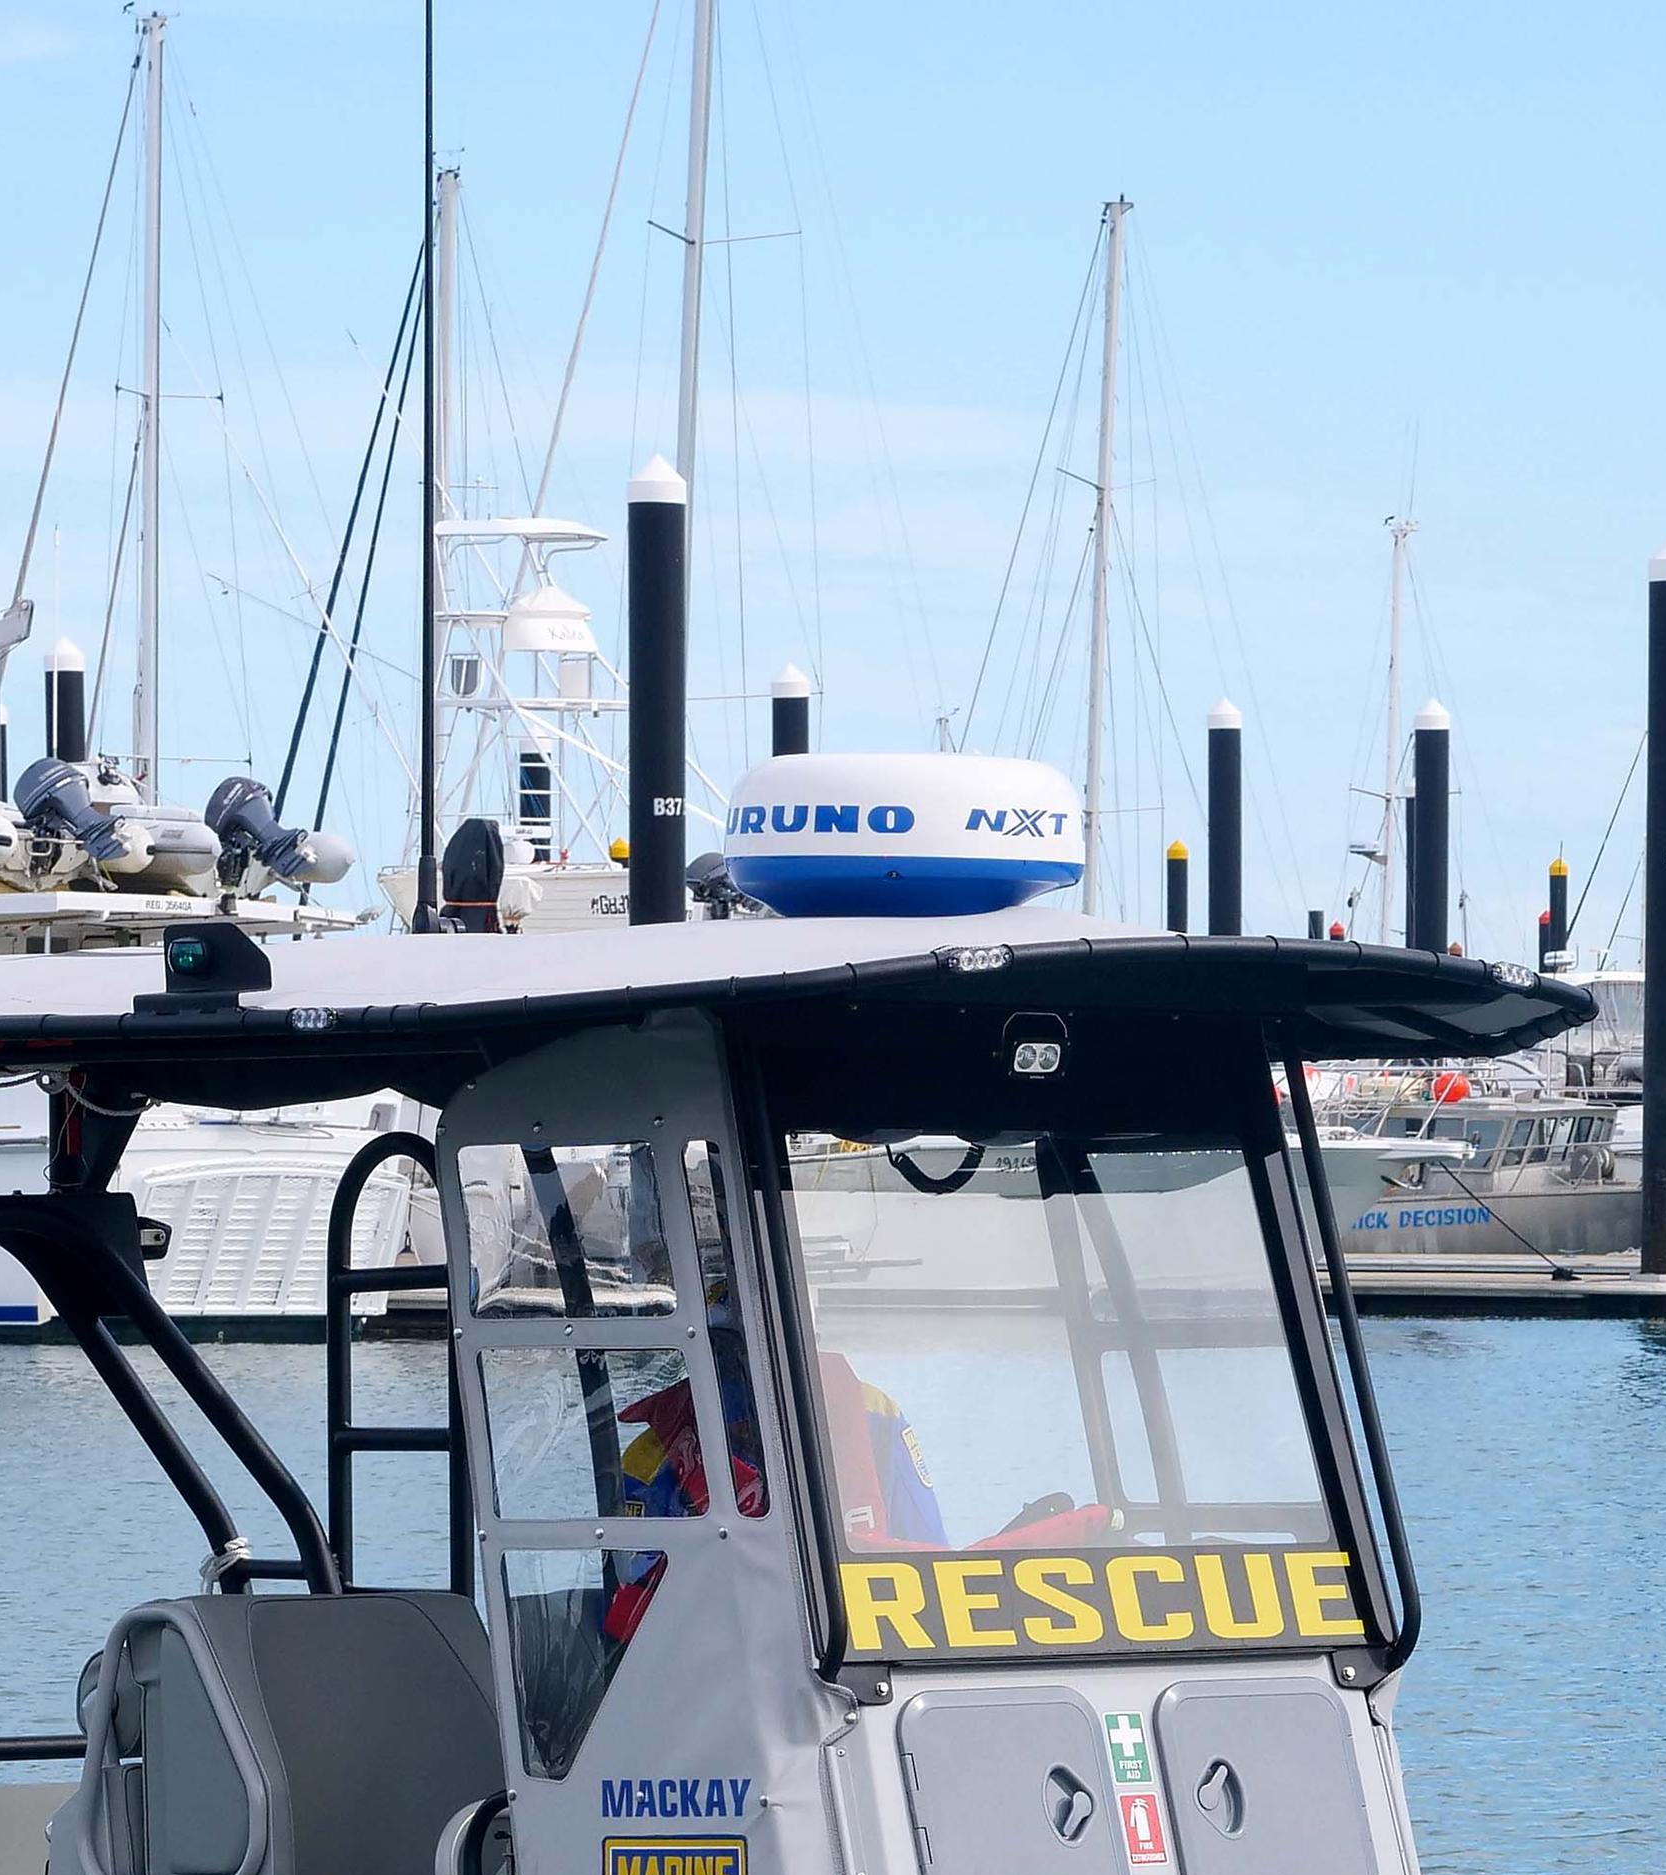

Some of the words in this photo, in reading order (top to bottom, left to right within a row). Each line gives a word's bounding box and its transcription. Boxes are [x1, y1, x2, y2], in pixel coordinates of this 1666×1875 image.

[726, 805, 915, 835] URUNO
[965, 808, 1068, 837] NXT
[1351, 1212, 1390, 1230] ICK
[1398, 1206, 1491, 1229] DECISION
[838, 1551, 1365, 1651] RESCUE
[601, 1778, 752, 1818] MACKAY
